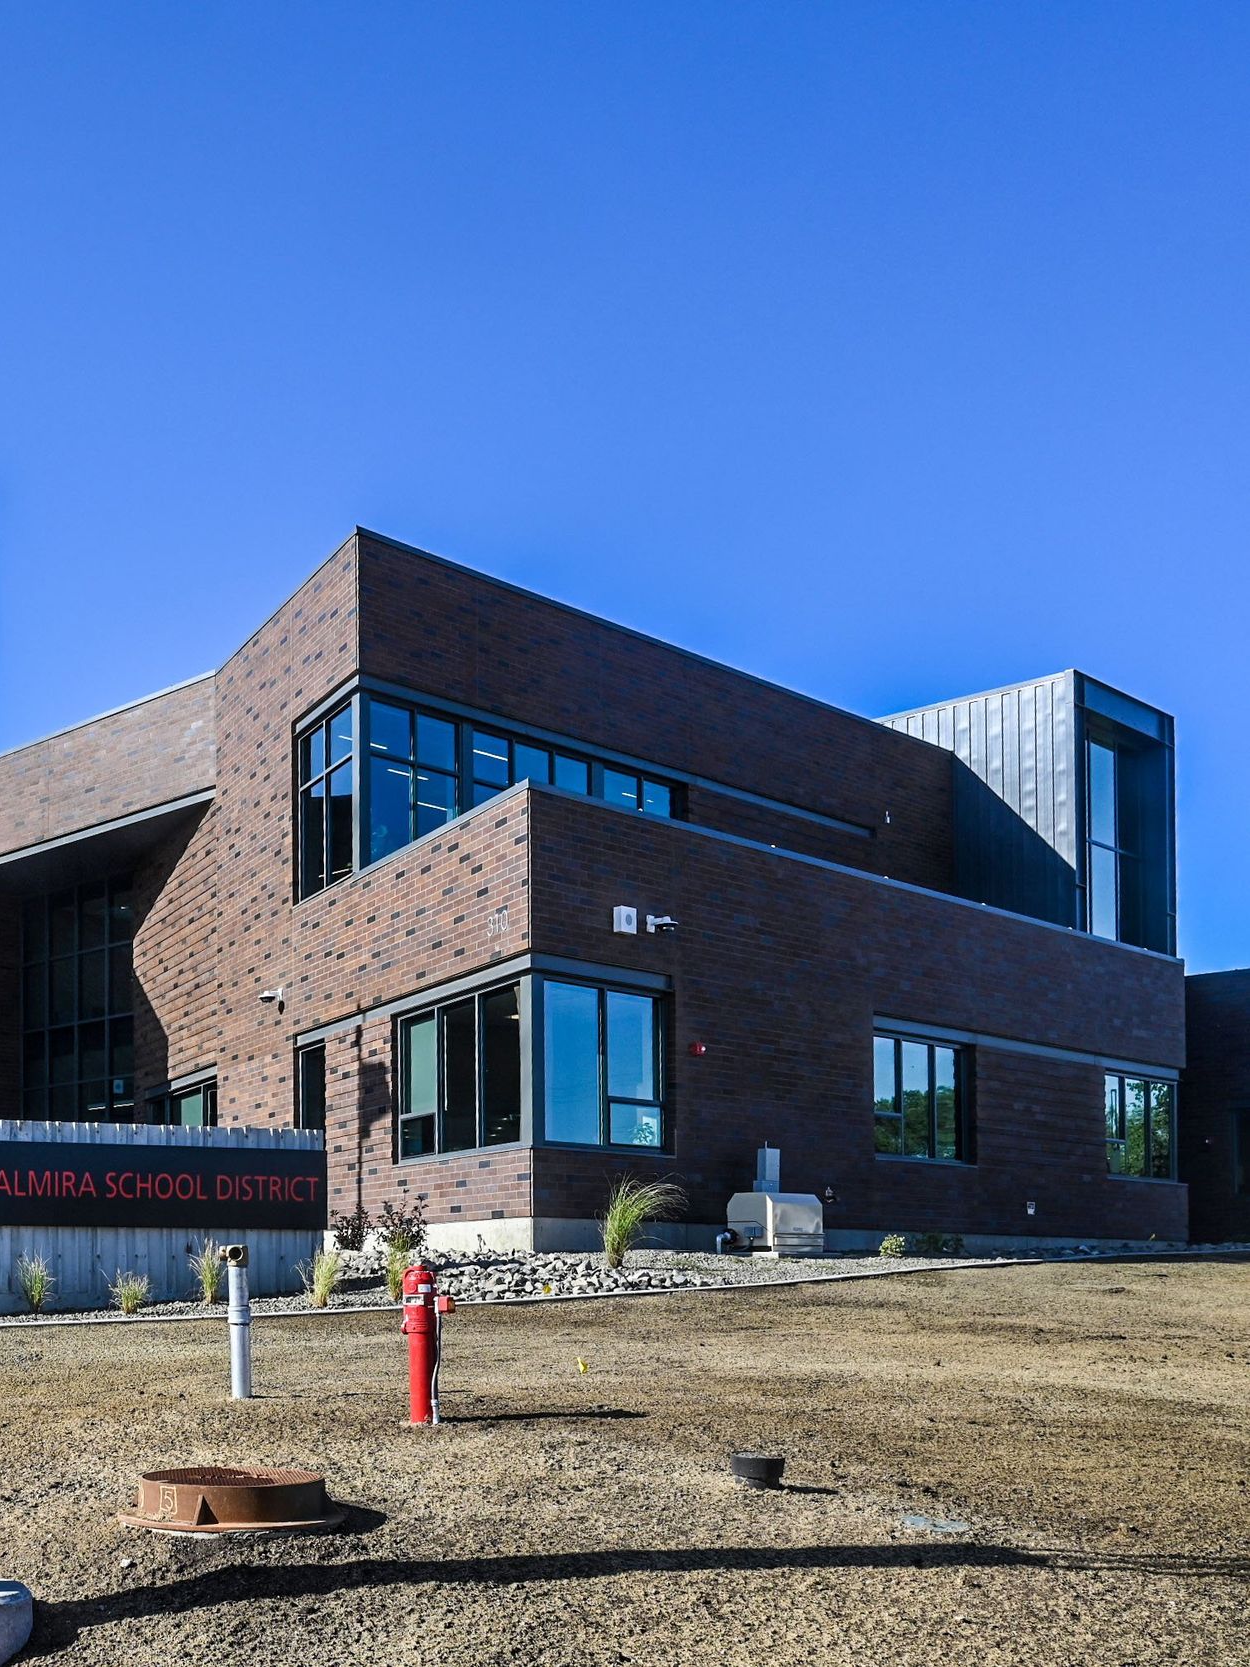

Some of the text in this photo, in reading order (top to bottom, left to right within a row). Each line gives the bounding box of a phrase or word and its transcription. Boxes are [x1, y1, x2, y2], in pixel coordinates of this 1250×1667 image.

[486, 910, 509, 937] 310
[105, 1171, 208, 1200] SCHOOL
[216, 1174, 319, 1202] DISTRICT
[164, 1490, 174, 1511] 5
